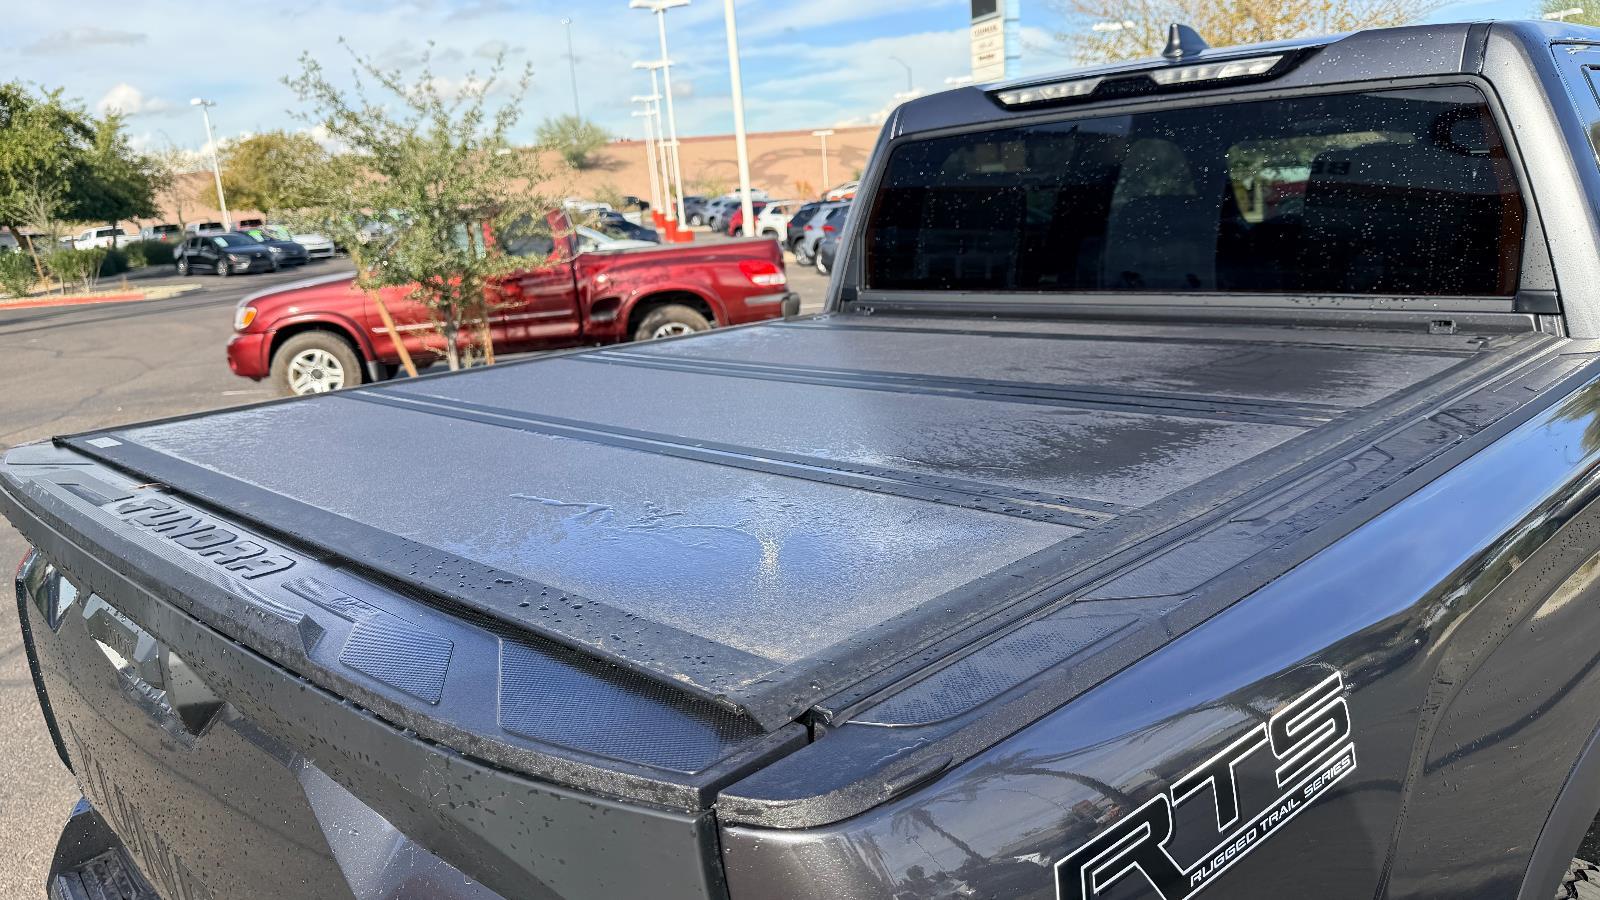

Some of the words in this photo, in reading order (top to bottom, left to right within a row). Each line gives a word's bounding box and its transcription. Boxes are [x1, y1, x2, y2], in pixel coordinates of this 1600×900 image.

[116, 497, 297, 579] TUNDRA
[1055, 672, 1350, 900] RTS
[1190, 829, 1257, 887] RUGGED
[1259, 799, 1301, 832] TRAIL
[1304, 756, 1351, 797] SERIES
